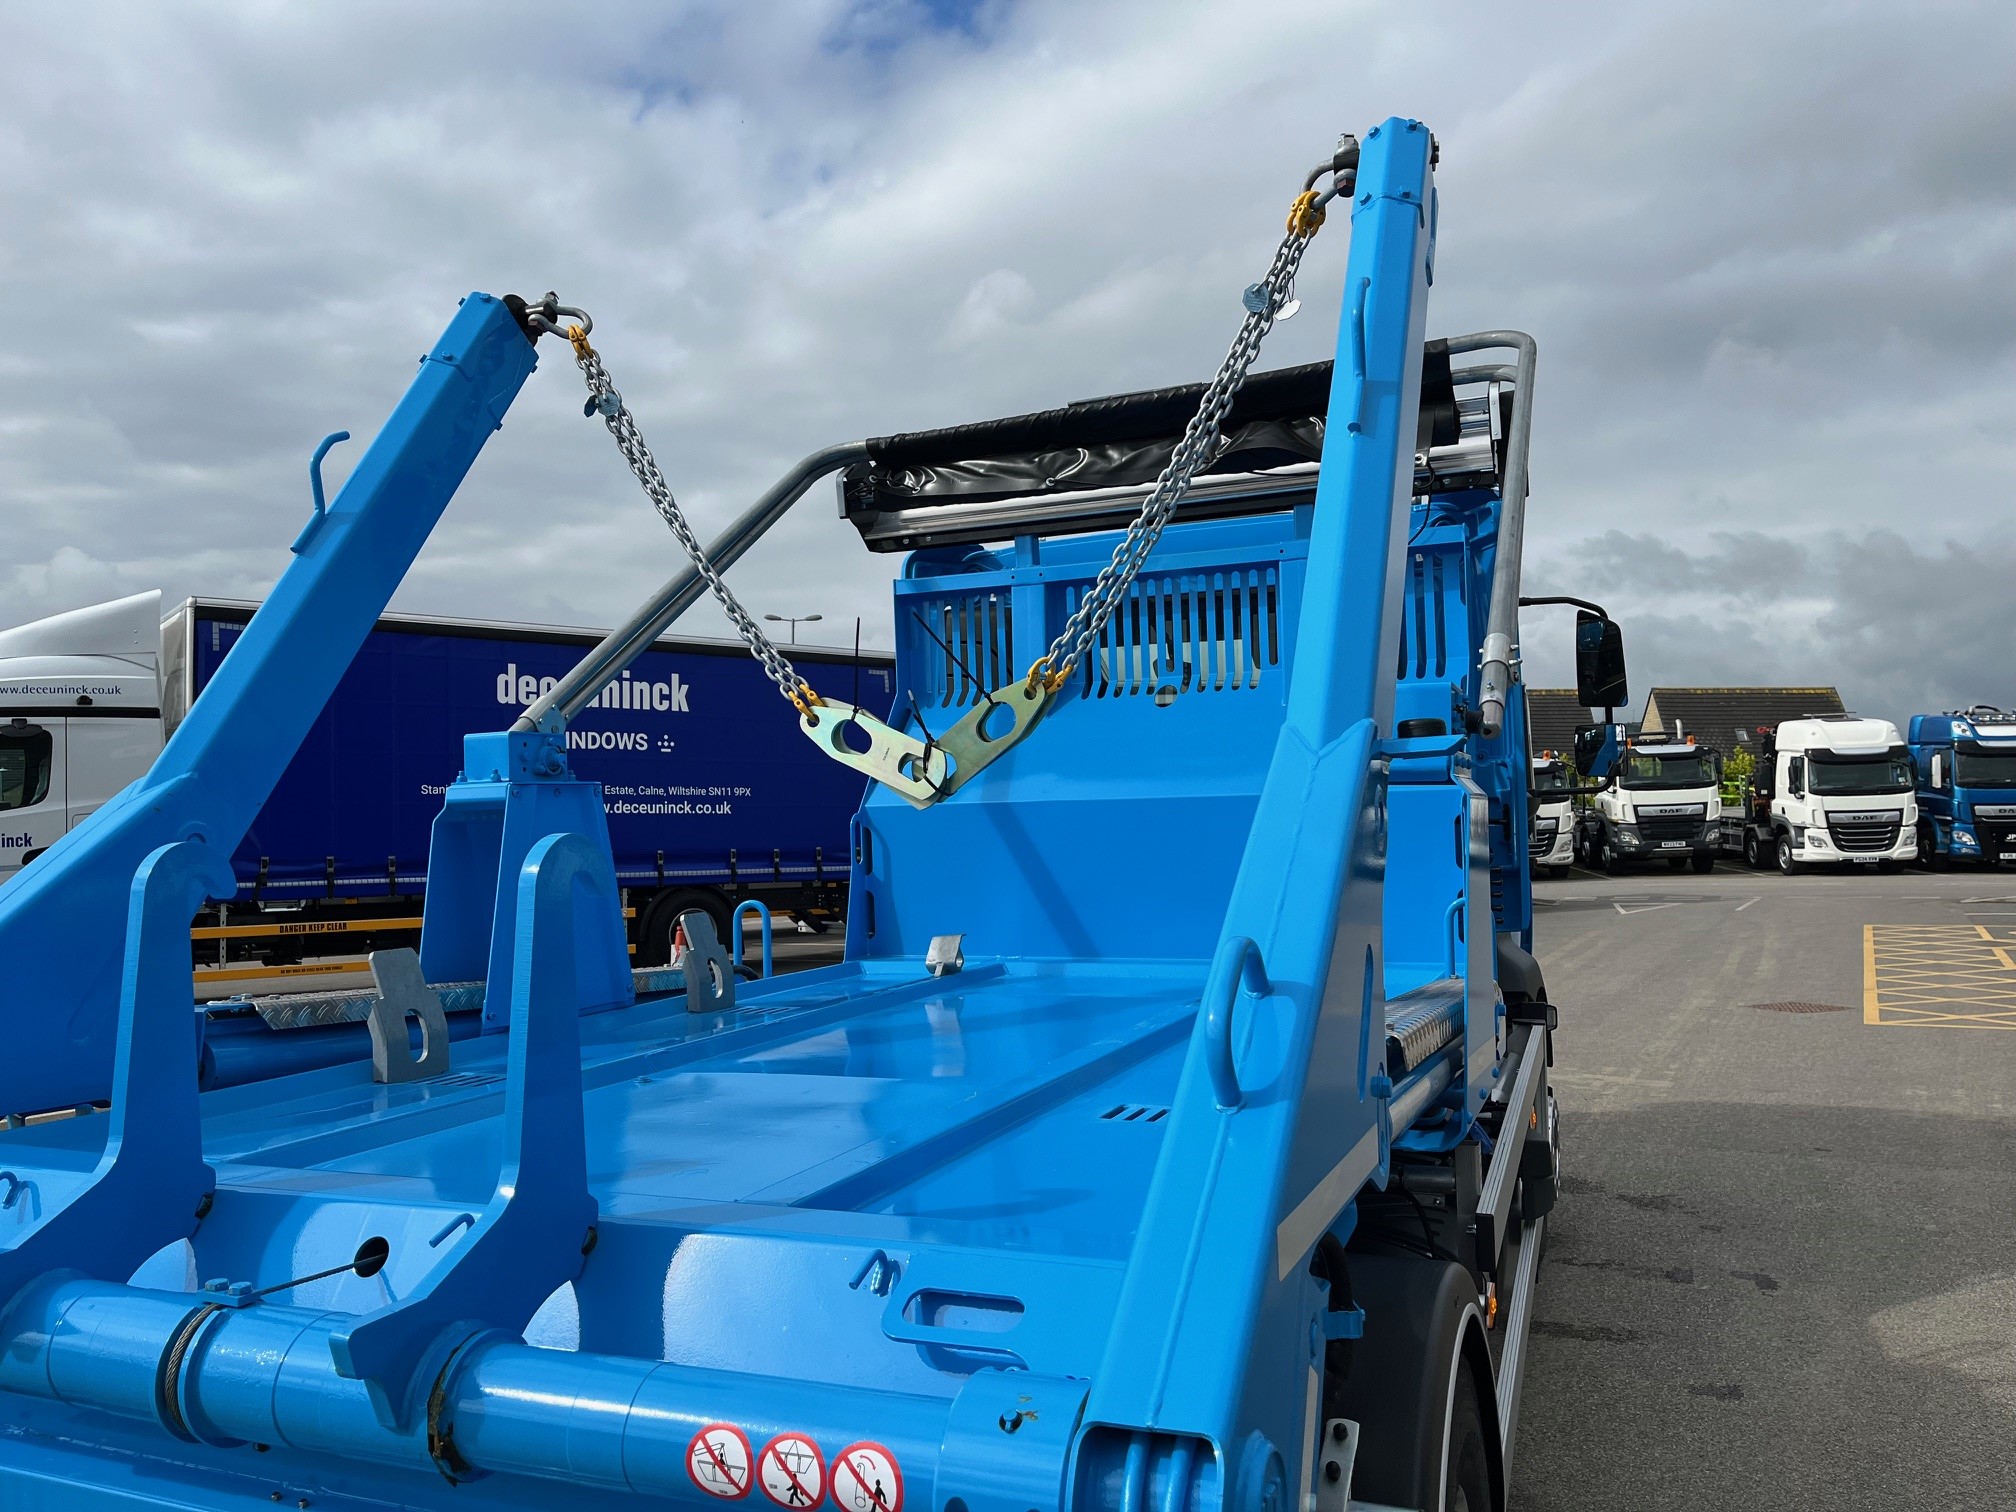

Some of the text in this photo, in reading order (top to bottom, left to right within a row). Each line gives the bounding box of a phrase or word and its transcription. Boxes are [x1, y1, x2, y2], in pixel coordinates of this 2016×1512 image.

[497, 663, 689, 712] decninck
[565, 731, 648, 750] INDOWS
[604, 785, 637, 797] Estate,
[638, 785, 667, 797] Calne,
[668, 786, 707, 796] Wiltshire
[708, 786, 731, 796] SN11
[733, 787, 751, 797] 9PX
[280, 923, 347, 934] DANGER KEEP CLEAR
